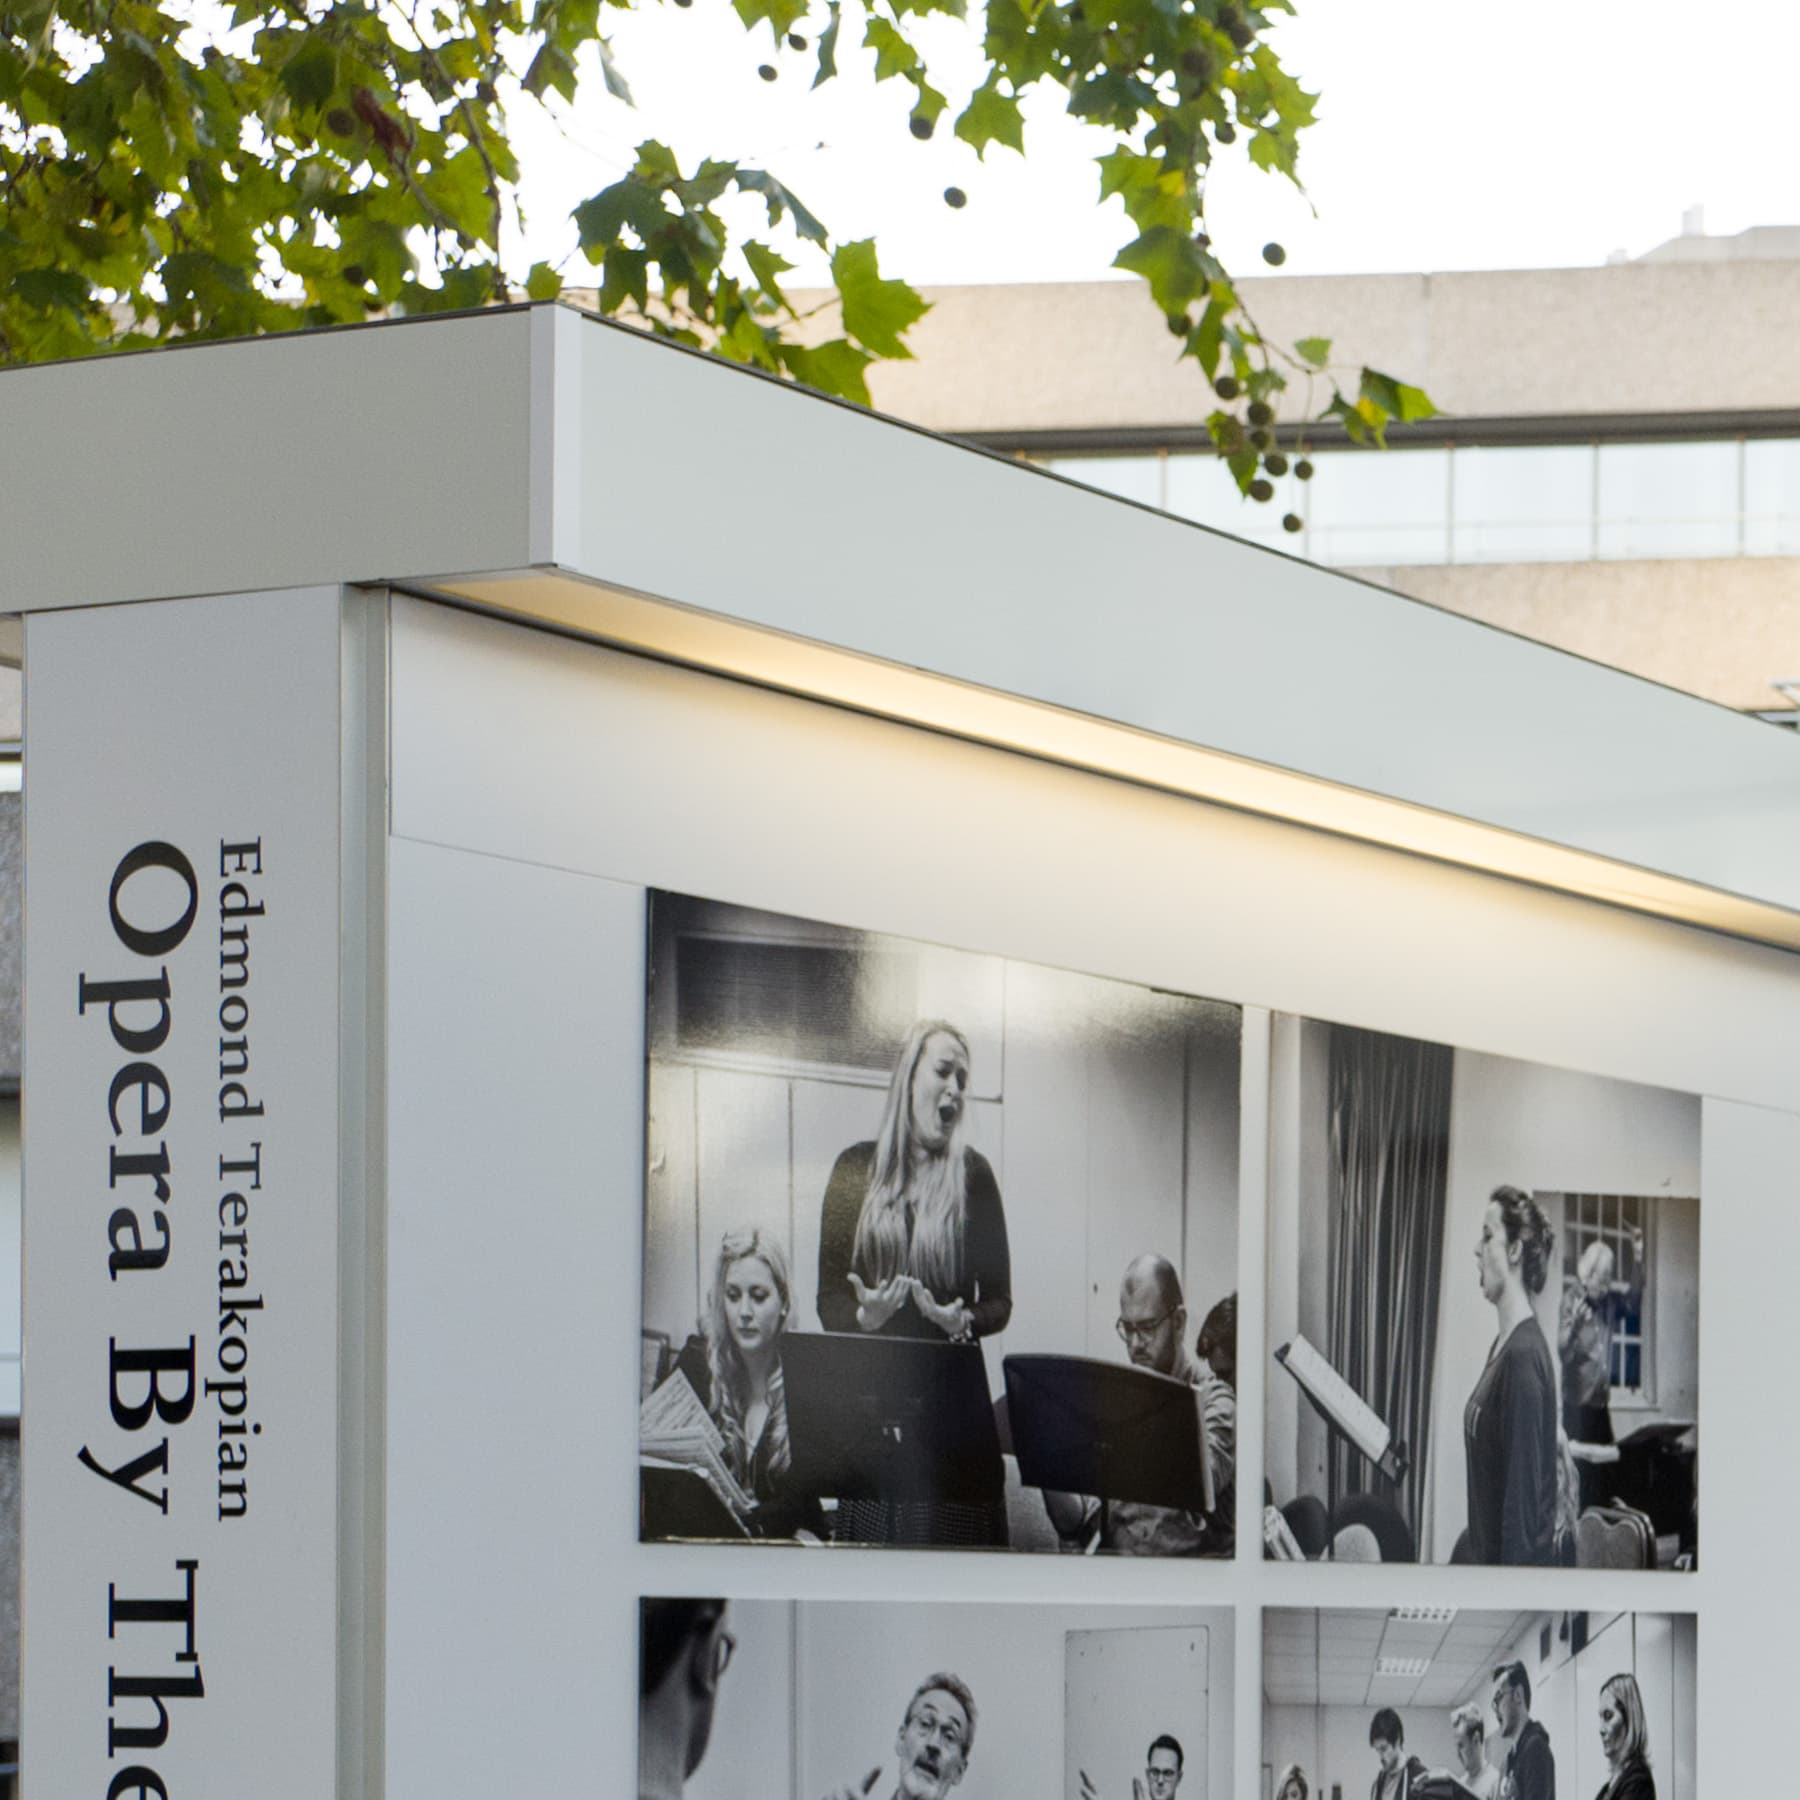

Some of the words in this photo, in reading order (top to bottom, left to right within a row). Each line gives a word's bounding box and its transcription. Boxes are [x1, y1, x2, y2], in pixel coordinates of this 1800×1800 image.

[79, 841, 198, 1281] Opera
[219, 837, 265, 1122] Edmond
[78, 1335, 195, 1515] By
[205, 1143, 263, 1521] Terakopian
